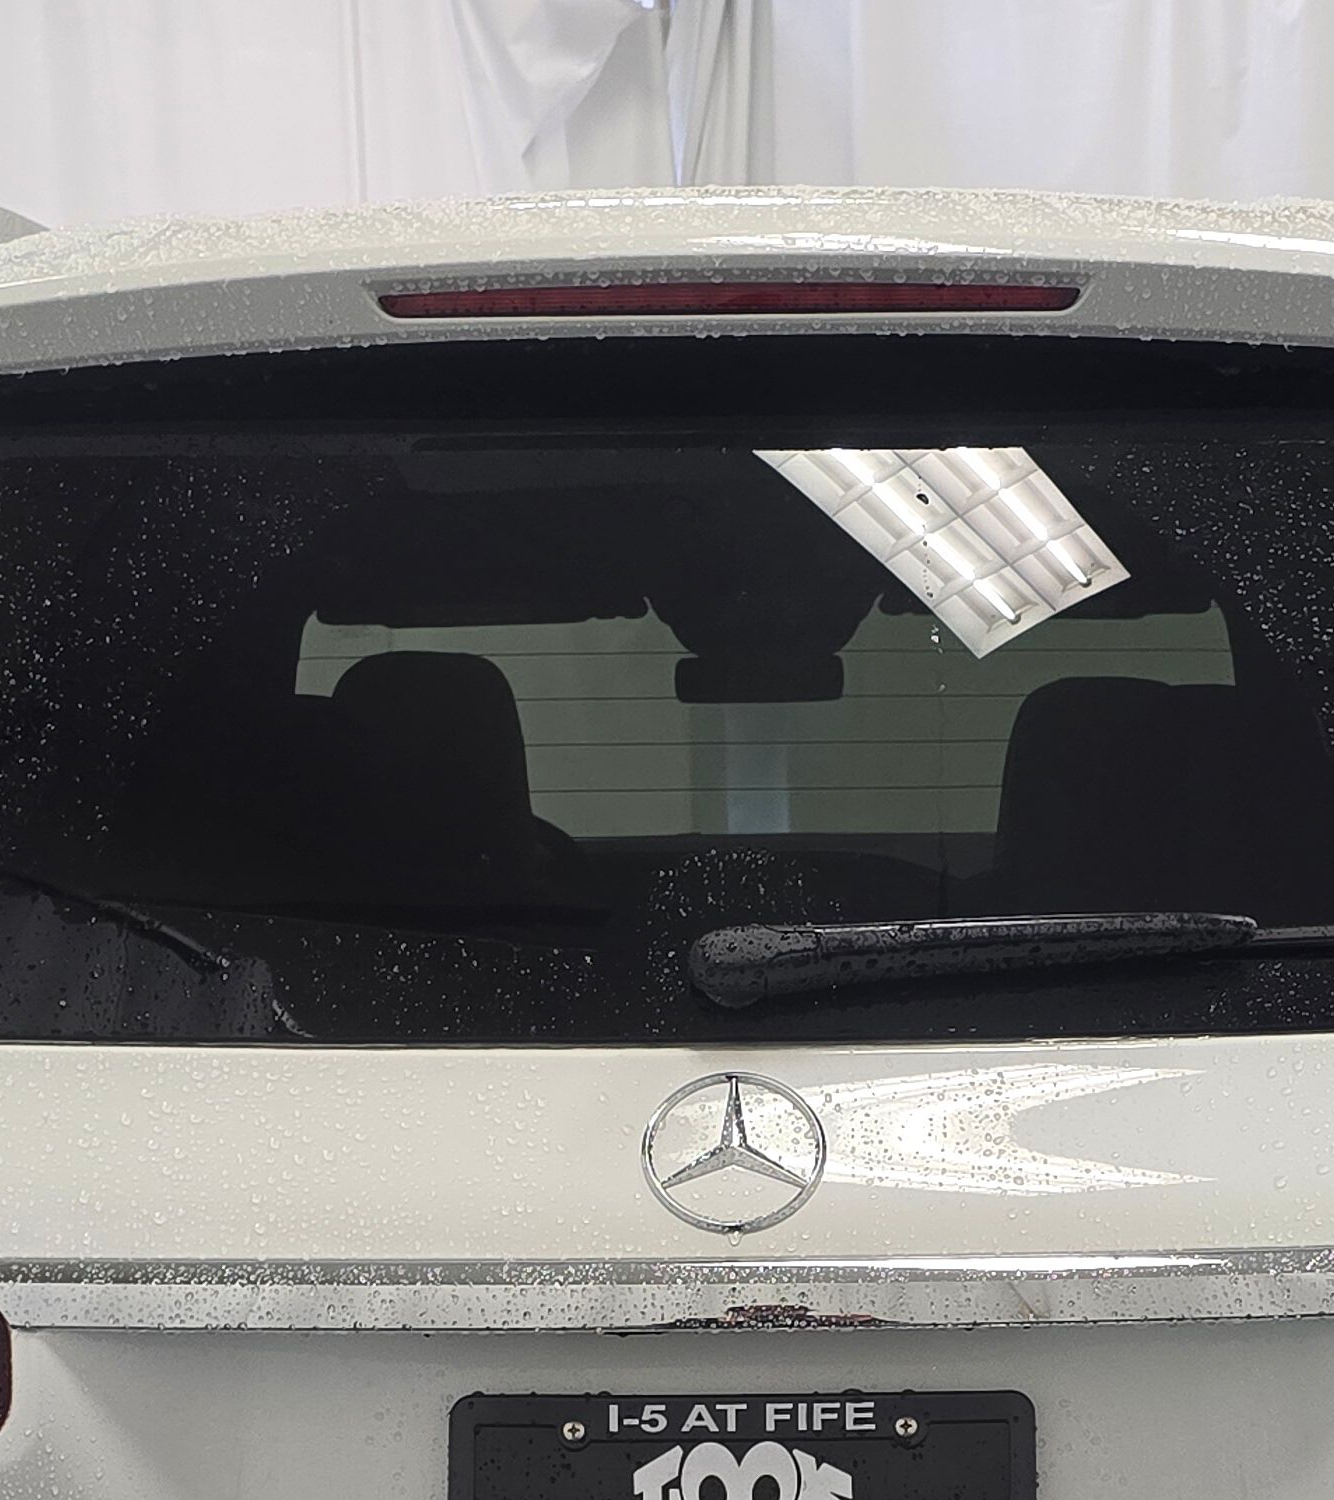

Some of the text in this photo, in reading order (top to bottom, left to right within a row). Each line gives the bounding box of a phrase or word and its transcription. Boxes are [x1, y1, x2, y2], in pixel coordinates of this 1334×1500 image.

[608, 1401, 876, 1432] I-5 AT FIFE
